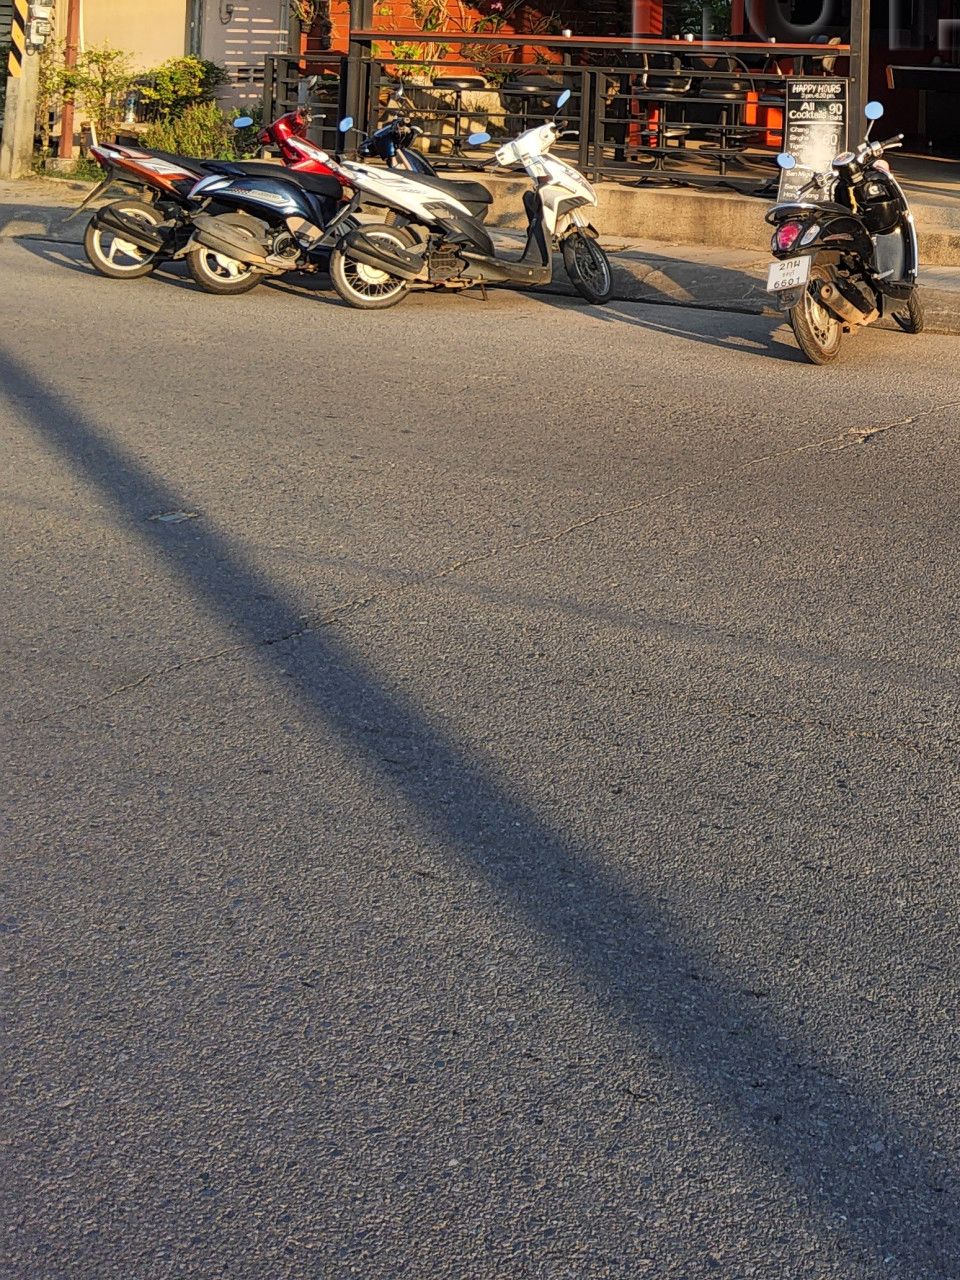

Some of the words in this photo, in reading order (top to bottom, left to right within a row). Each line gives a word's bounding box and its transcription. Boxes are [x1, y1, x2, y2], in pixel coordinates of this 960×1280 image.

[792, 84, 817, 94] HAPPY
[818, 84, 842, 94] HOURS
[789, 109, 827, 120] Cocktails
[828, 103, 843, 115] 90
[801, 102, 815, 111] All
